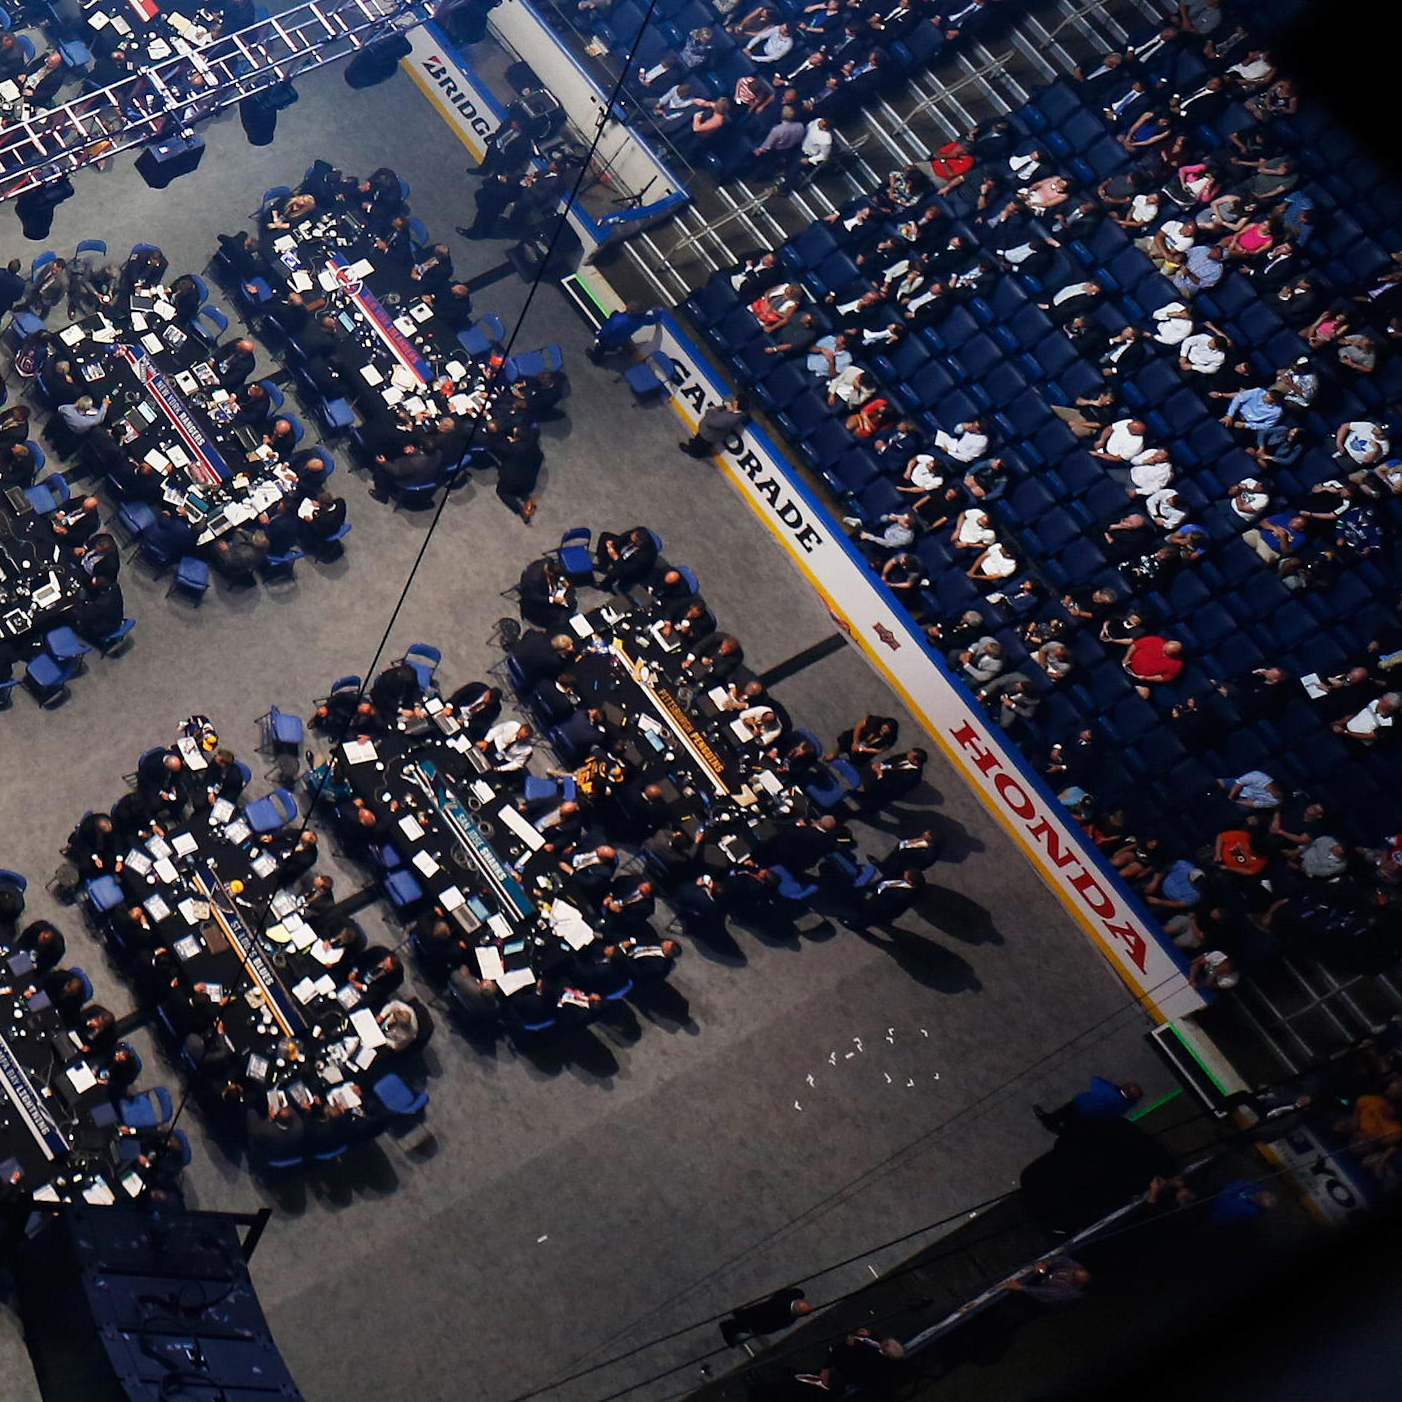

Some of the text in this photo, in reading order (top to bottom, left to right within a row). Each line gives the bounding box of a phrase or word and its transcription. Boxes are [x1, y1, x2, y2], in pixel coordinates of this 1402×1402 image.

[155, 379, 206, 446] NEW YORK RANGERS
[669, 358, 823, 553] GAORADE
[656, 687, 725, 774] PITTSBURGH PENGUINS
[455, 812, 508, 882] SAN JOSE SHARKS
[949, 719, 1146, 975] HONDA
[229, 919, 243, 935] ST.
[251, 956, 275, 986] BLUES
[5, 1068, 21, 1086] BAY
[15, 1084, 51, 1135] LIGHTNING
